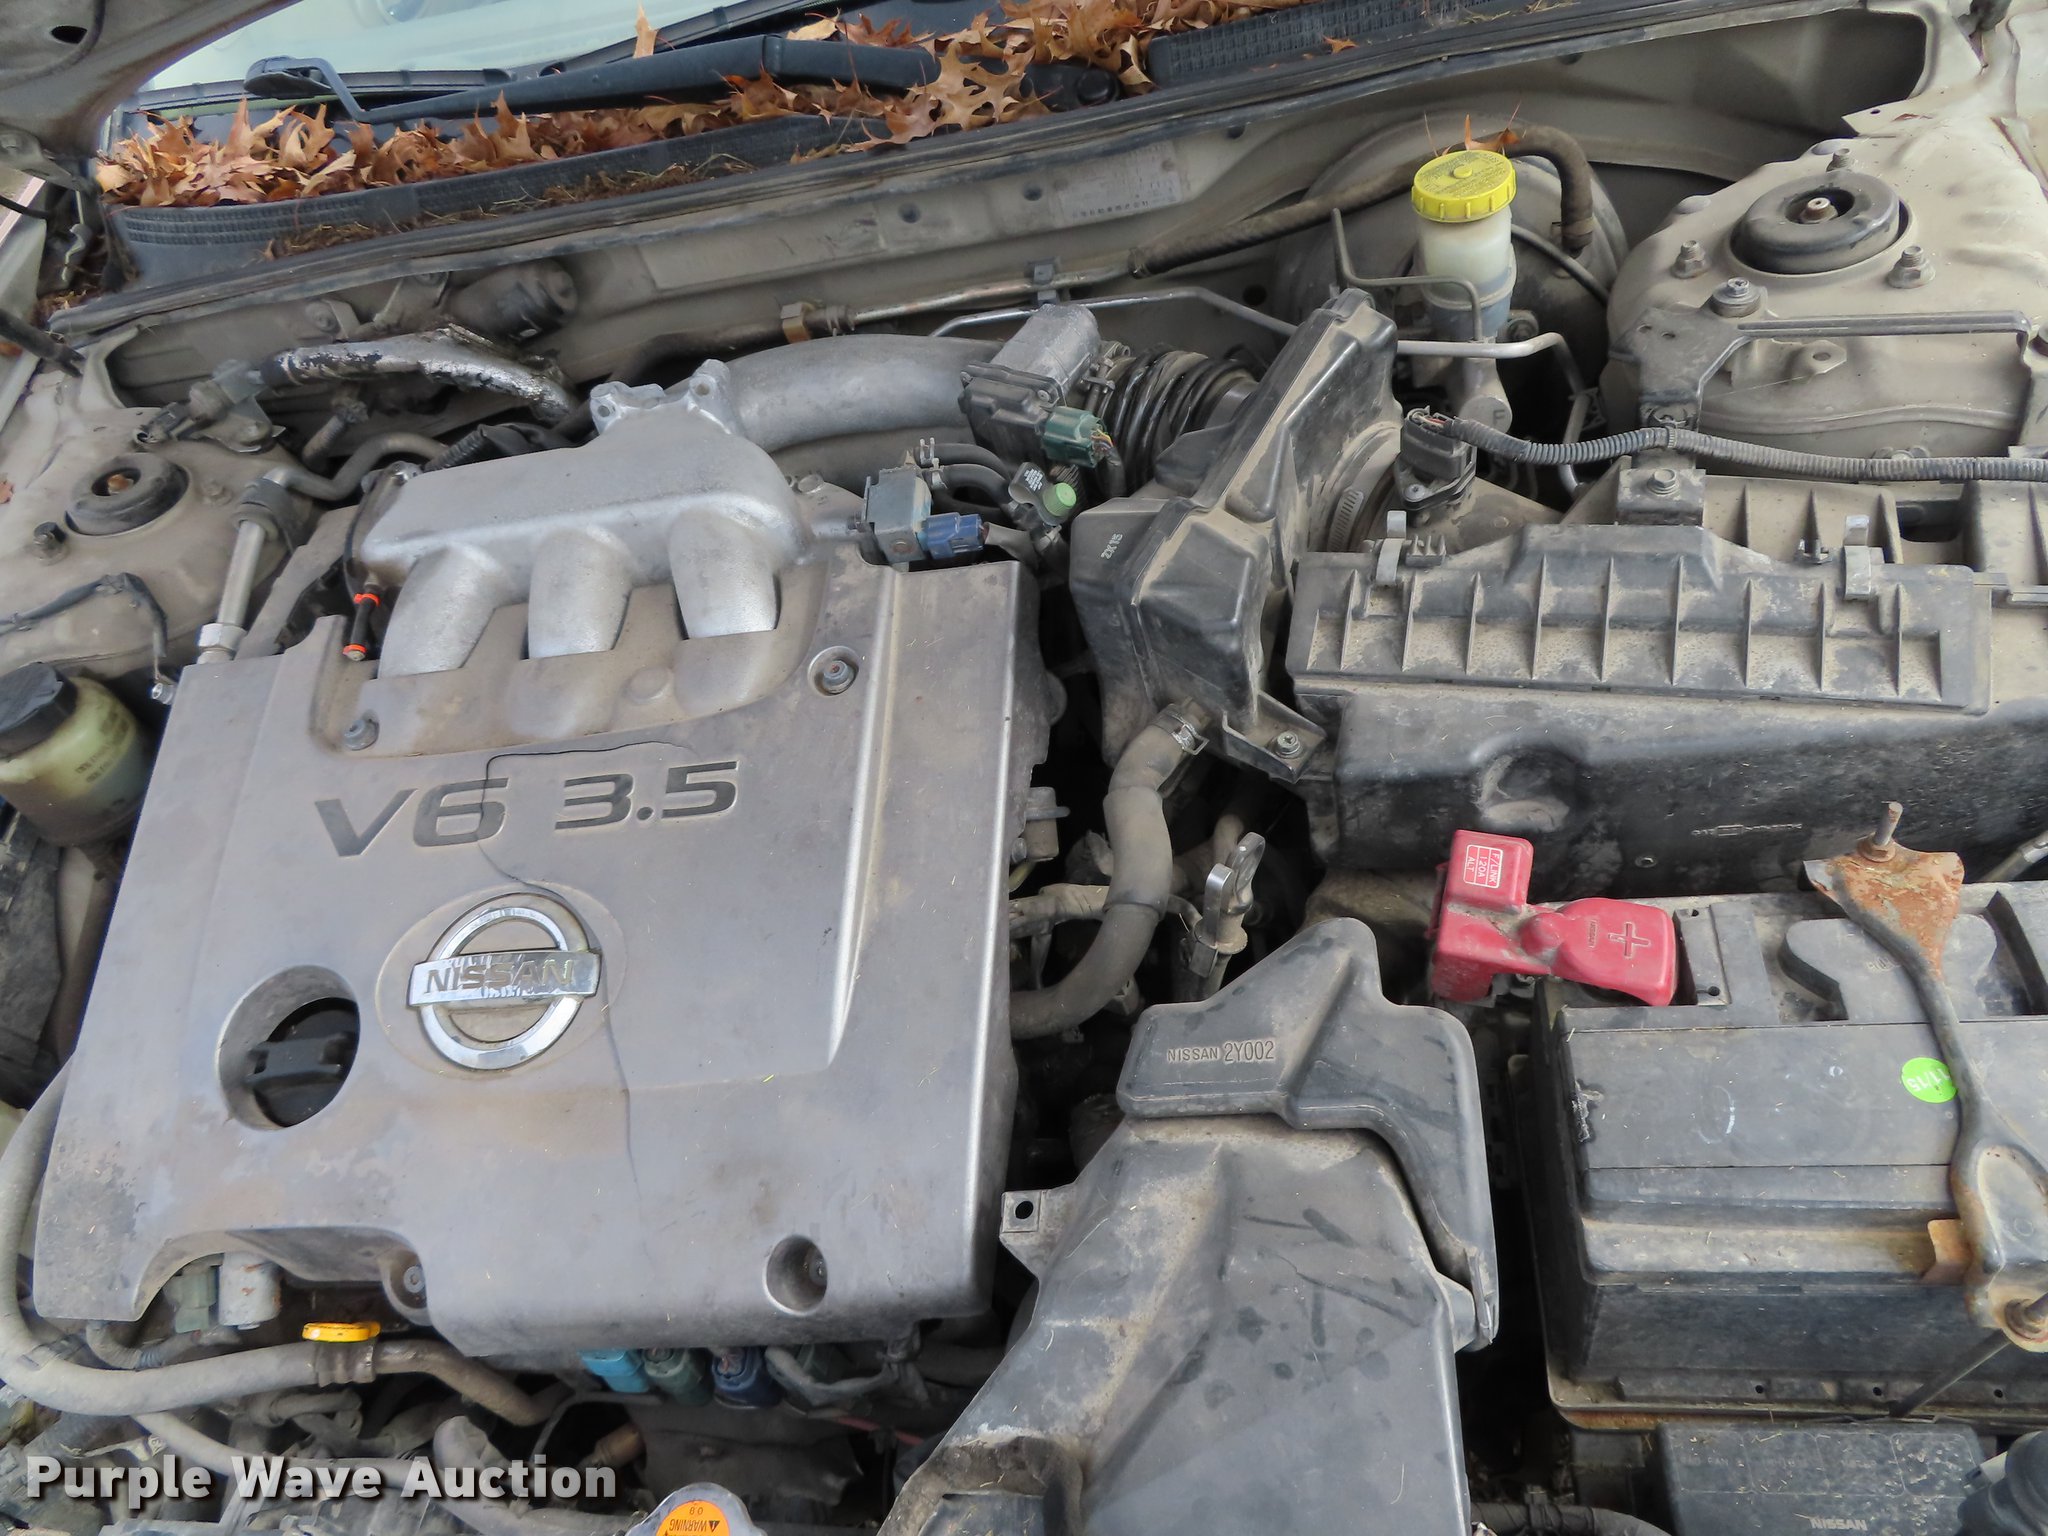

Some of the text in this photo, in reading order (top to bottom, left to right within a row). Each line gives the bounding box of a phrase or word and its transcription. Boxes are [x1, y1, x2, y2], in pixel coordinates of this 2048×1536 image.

[314, 760, 739, 858] V6 3.5
[1466, 856, 1476, 873] ALT
[1477, 856, 1488, 878] 120A
[1488, 853, 1500, 884] F/LINK
[424, 959, 574, 994] NISSAN
[1167, 1040, 1275, 1063] NISSAN 2Y002
[668, 1518, 707, 1533] WARNING
[1809, 1518, 1868, 1531] NISSAN
